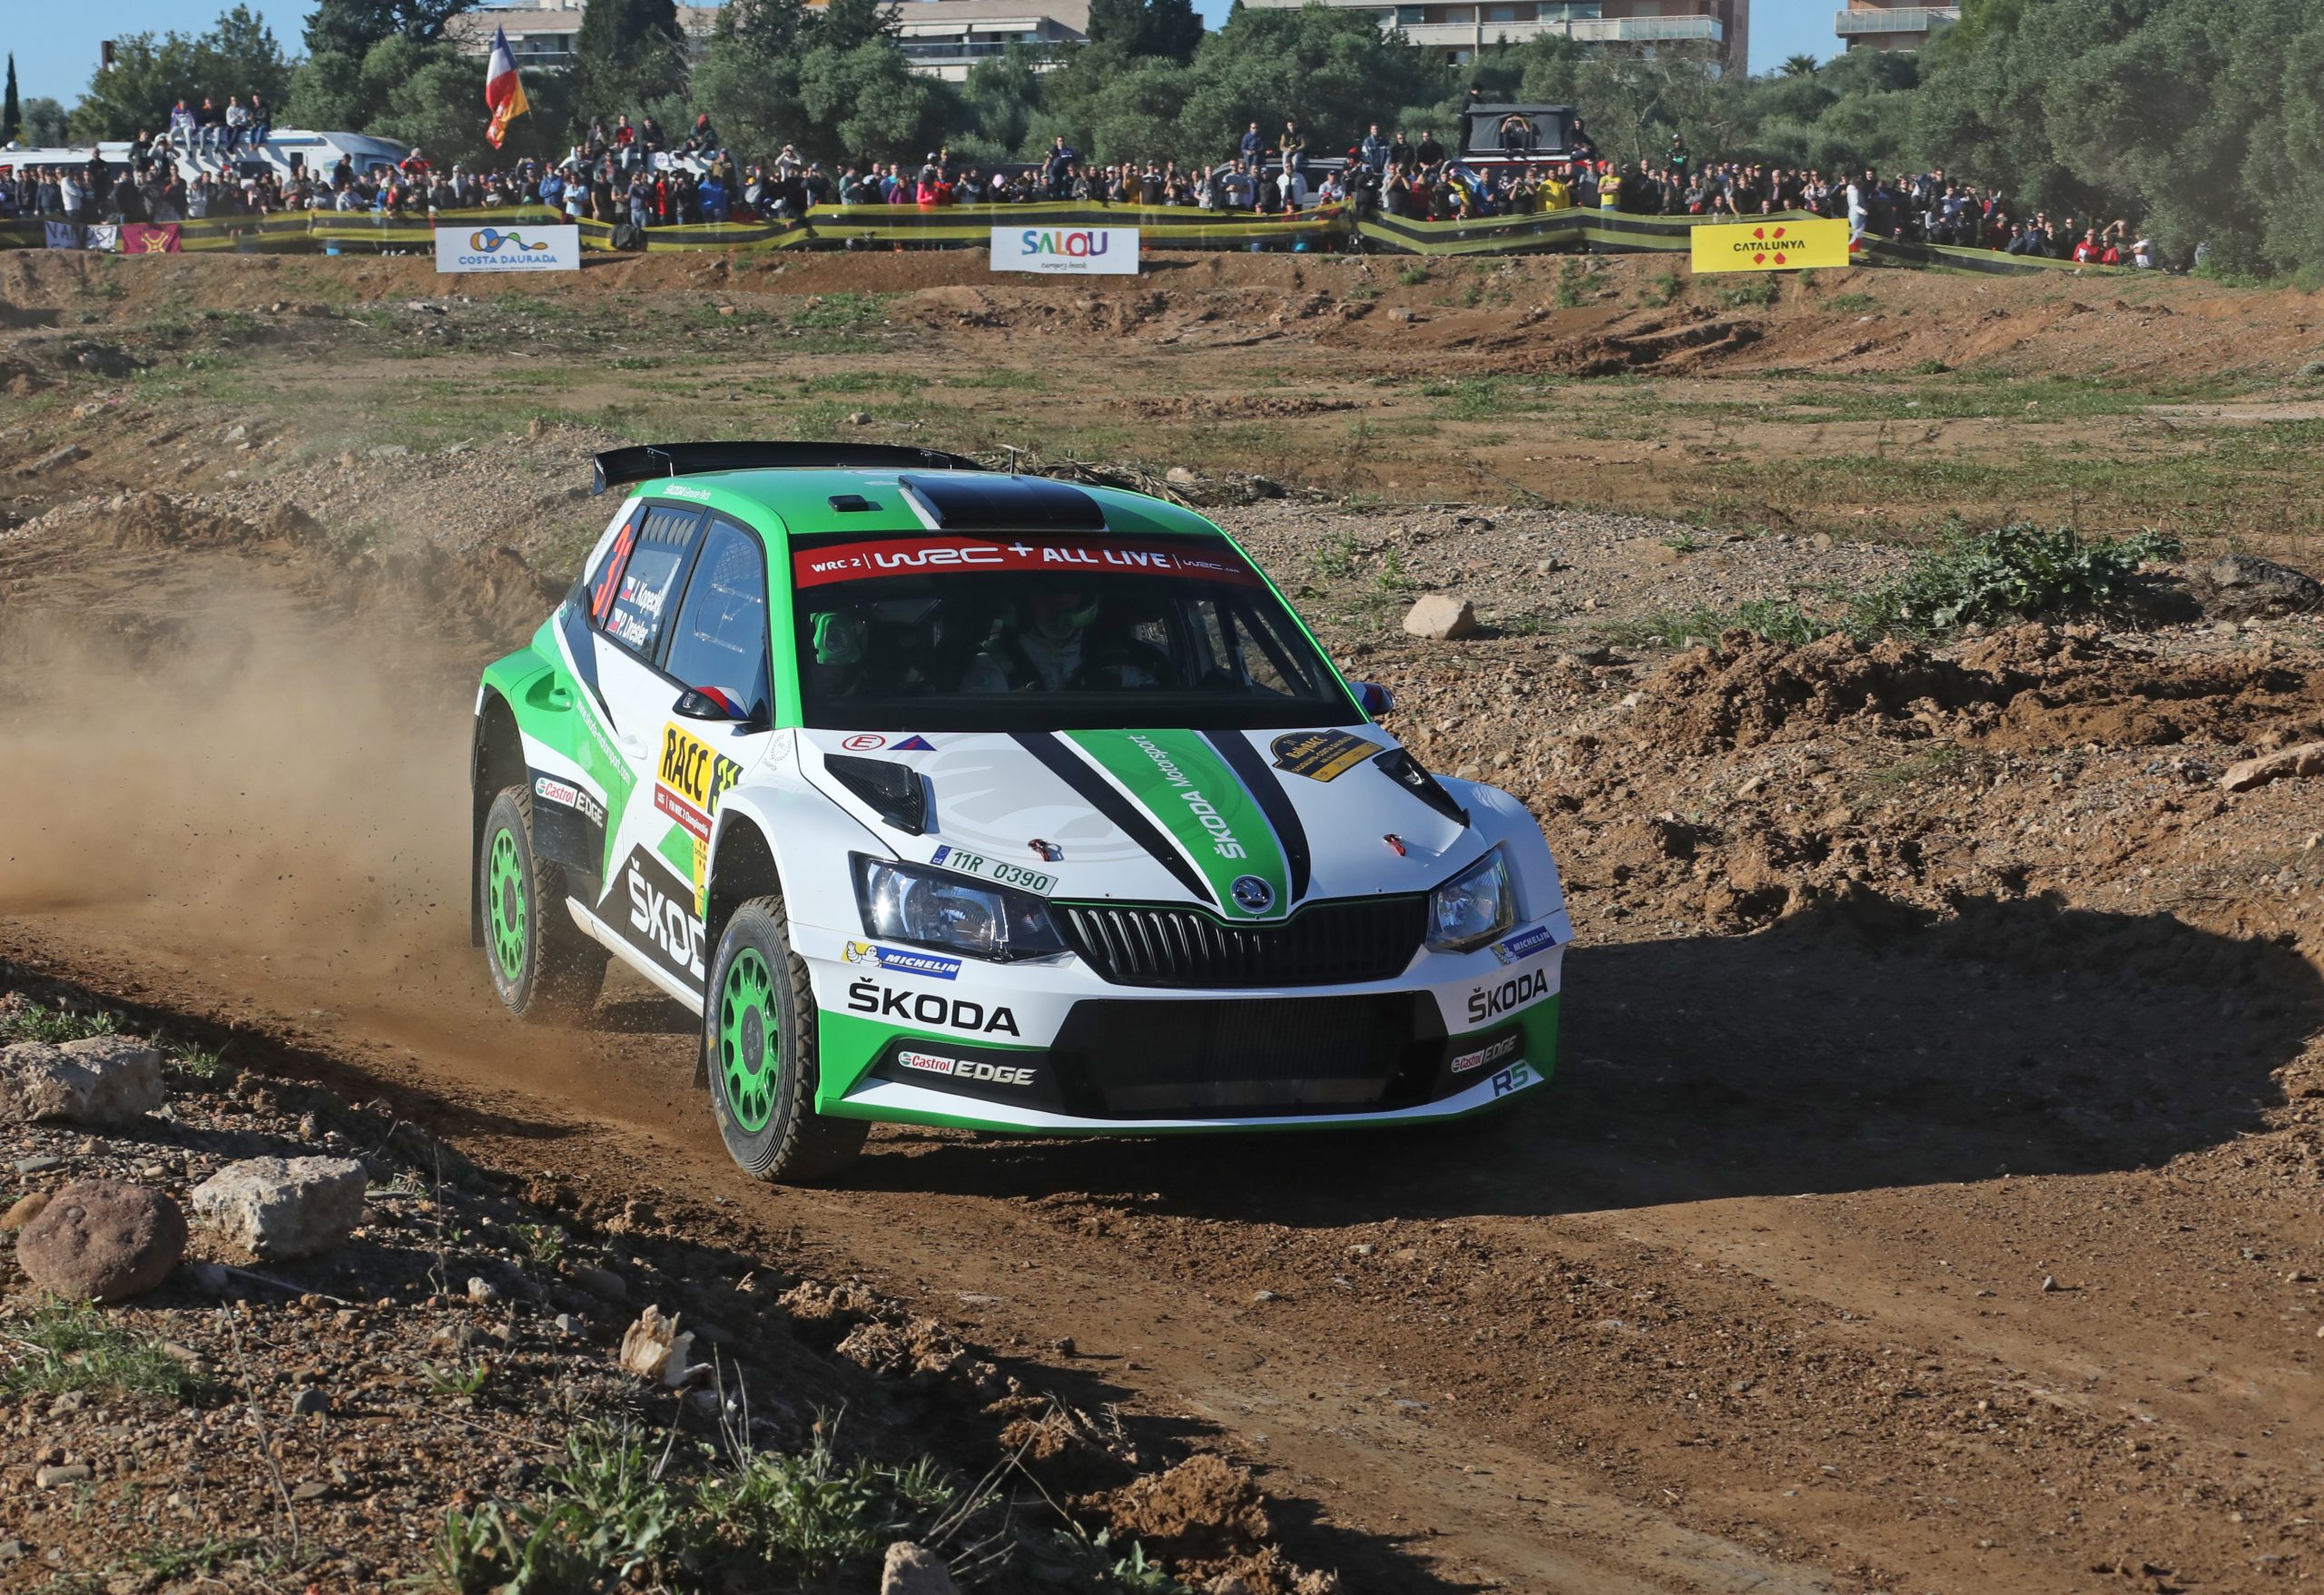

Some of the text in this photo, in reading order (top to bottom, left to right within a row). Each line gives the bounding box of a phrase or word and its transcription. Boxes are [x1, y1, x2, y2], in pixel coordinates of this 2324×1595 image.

[458, 254, 557, 265] COSTA DAURADA
[1021, 230, 1108, 257] SALOU
[1733, 240, 1806, 251] CATALUNYA
[812, 559, 847, 572] WRC
[851, 558, 862, 566] 2
[1043, 547, 1099, 563] ALL
[1103, 549, 1171, 568] LIVE
[615, 613, 649, 646] P. Dresler
[852, 736, 877, 748] E
[663, 728, 708, 802] RACC
[545, 783, 603, 828] Castrol EDGE
[1127, 735, 1247, 859] ŠKODA Motorsport
[952, 852, 1049, 891] 11R 0390
[1513, 930, 1551, 952] MICHELIN
[884, 954, 960, 973] MICHELIN
[848, 976, 1020, 1038] ŠKODA
[1468, 968, 1549, 1024] ŠKODA
[1460, 1035, 1518, 1070] Castrol EDGE
[911, 1055, 1038, 1086] Castrol EDGE
[1492, 1062, 1529, 1098] R5
